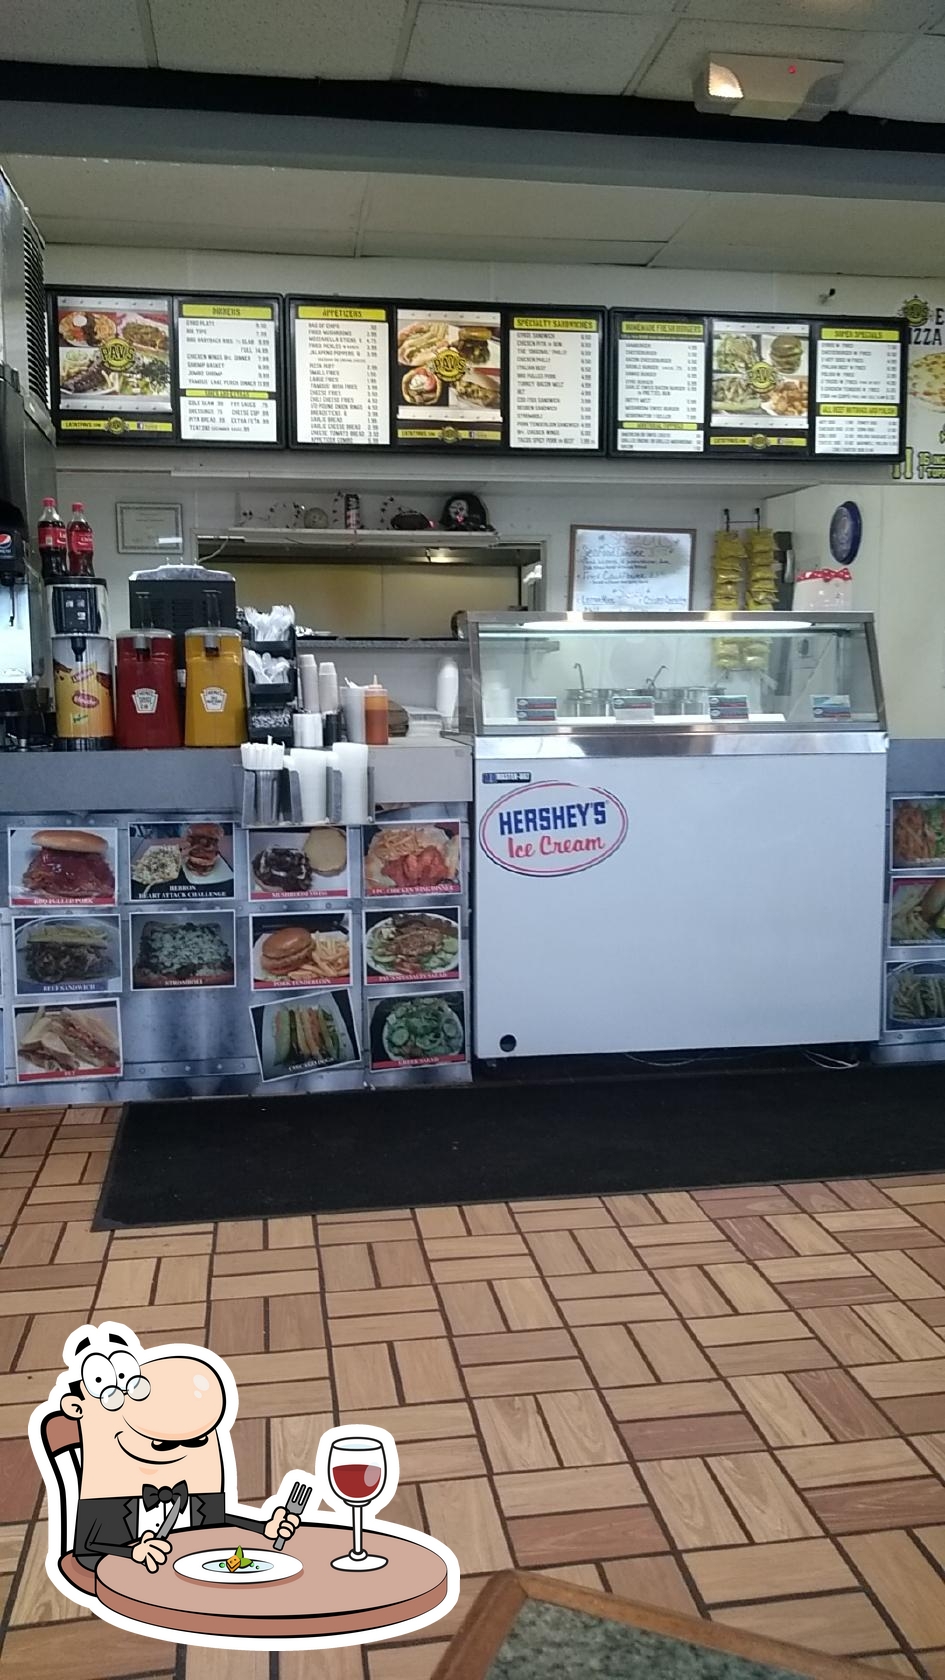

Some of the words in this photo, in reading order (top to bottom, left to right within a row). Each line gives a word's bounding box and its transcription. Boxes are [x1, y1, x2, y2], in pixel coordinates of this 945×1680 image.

[322, 309, 362, 318] APPETIZERS
[517, 319, 552, 327] SPECIALTY
[553, 320, 593, 329] SANDWICHES
[499, 801, 607, 836] HERSHEY'S
[508, 837, 536, 858] Ice
[539, 835, 606, 856] Cream
